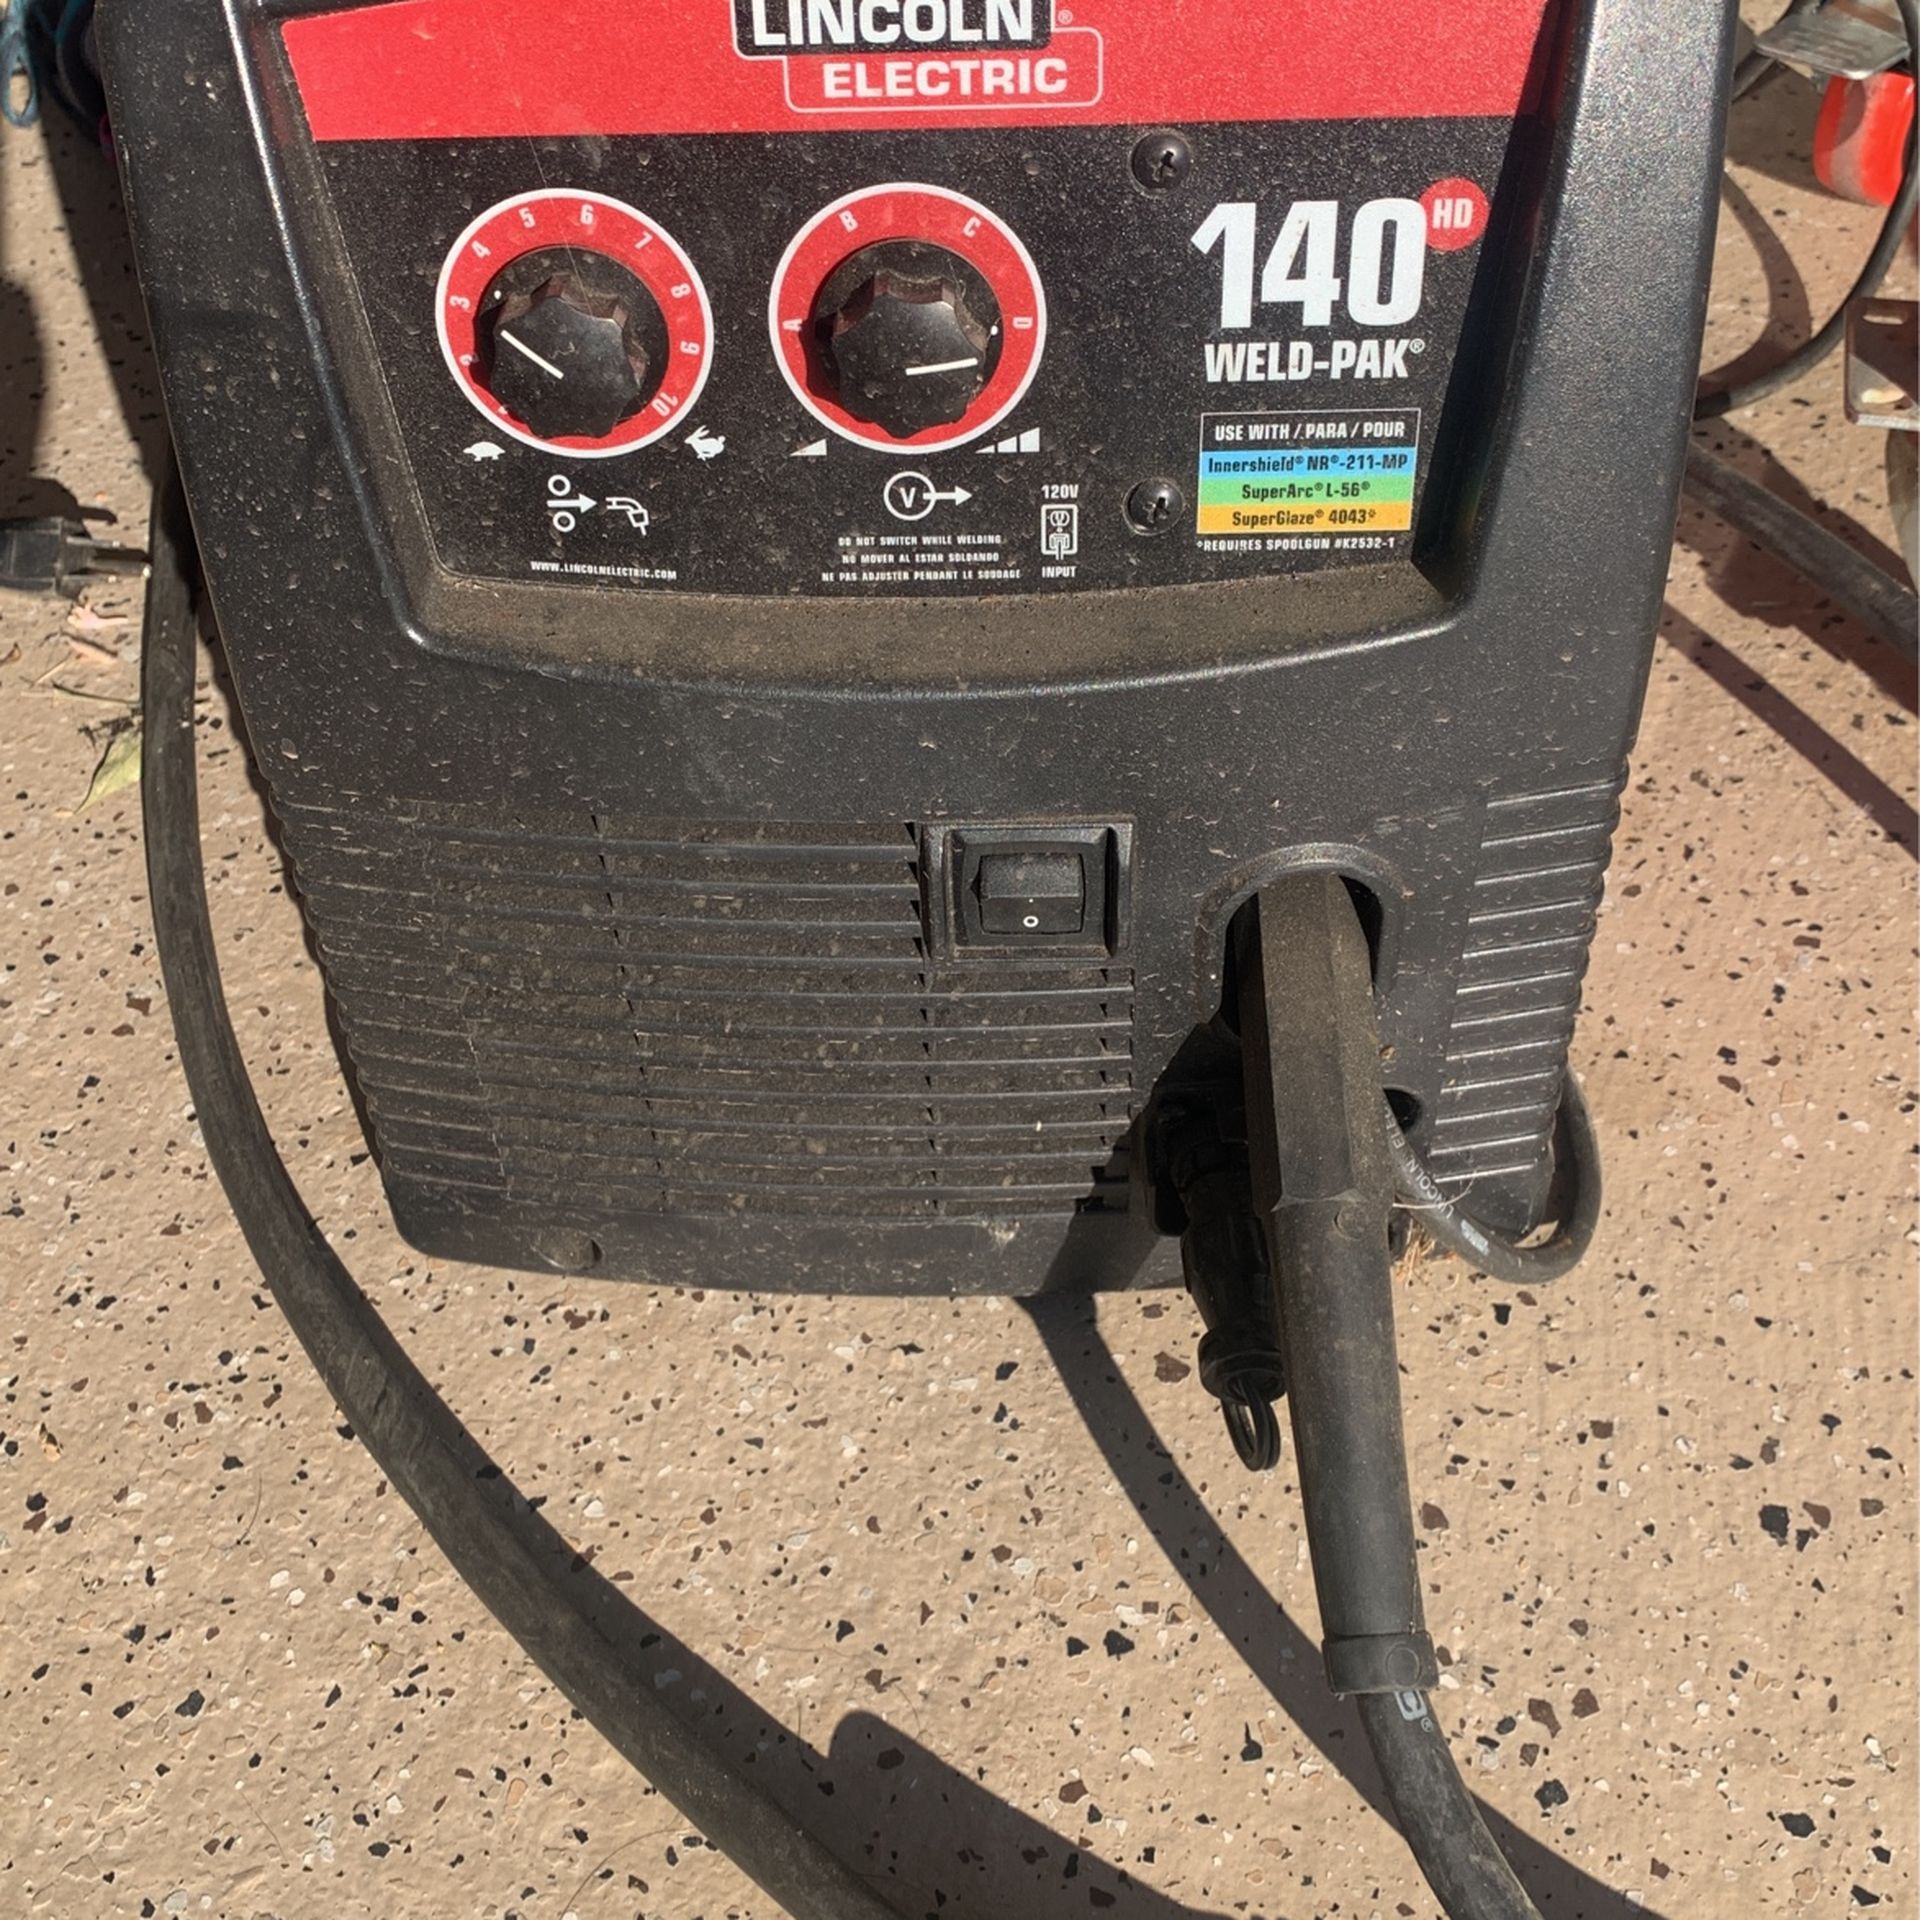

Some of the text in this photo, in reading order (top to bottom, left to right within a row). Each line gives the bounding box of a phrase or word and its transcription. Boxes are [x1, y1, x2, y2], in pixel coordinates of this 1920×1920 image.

[752, 0, 1033, 46] LINCOLN
[822, 58, 1068, 98] ELECTRIC
[518, 207, 536, 229] 5
[579, 204, 594, 225] 6
[839, 210, 858, 232] B
[1432, 198, 1473, 229] HD
[962, 216, 981, 237] C
[471, 240, 492, 258] 4
[634, 231, 653, 250] 7
[1190, 197, 1427, 328] 140
[670, 283, 691, 299] 8
[450, 295, 471, 310] 3
[782, 318, 803, 332] A
[1012, 316, 1033, 329] D
[680, 340, 700, 355] 9
[651, 391, 678, 417] 10
[1215, 425, 1243, 441] USE
[1249, 423, 1290, 440] WITH
[1305, 422, 1348, 439] PARA
[1362, 421, 1405, 438] POUR
[1041, 484, 1079, 499] 120V
[837, 534, 1002, 546] DO NOT SWITCH WHILE WELDING
[1266, 538, 1330, 550] SPOOLGUN
[860, 553, 895, 563] MOVER
[899, 553, 911, 563] AL
[915, 553, 944, 562] ESTAR
[948, 552, 1000, 562] SOLDANDO
[530, 561, 677, 580] WWW.LINCOLNELECTRIC.COM
[821, 569, 1021, 582] NE PAS ADJUSTER PENDANT LE SOUDAGE
[1041, 566, 1077, 578] INPUT
